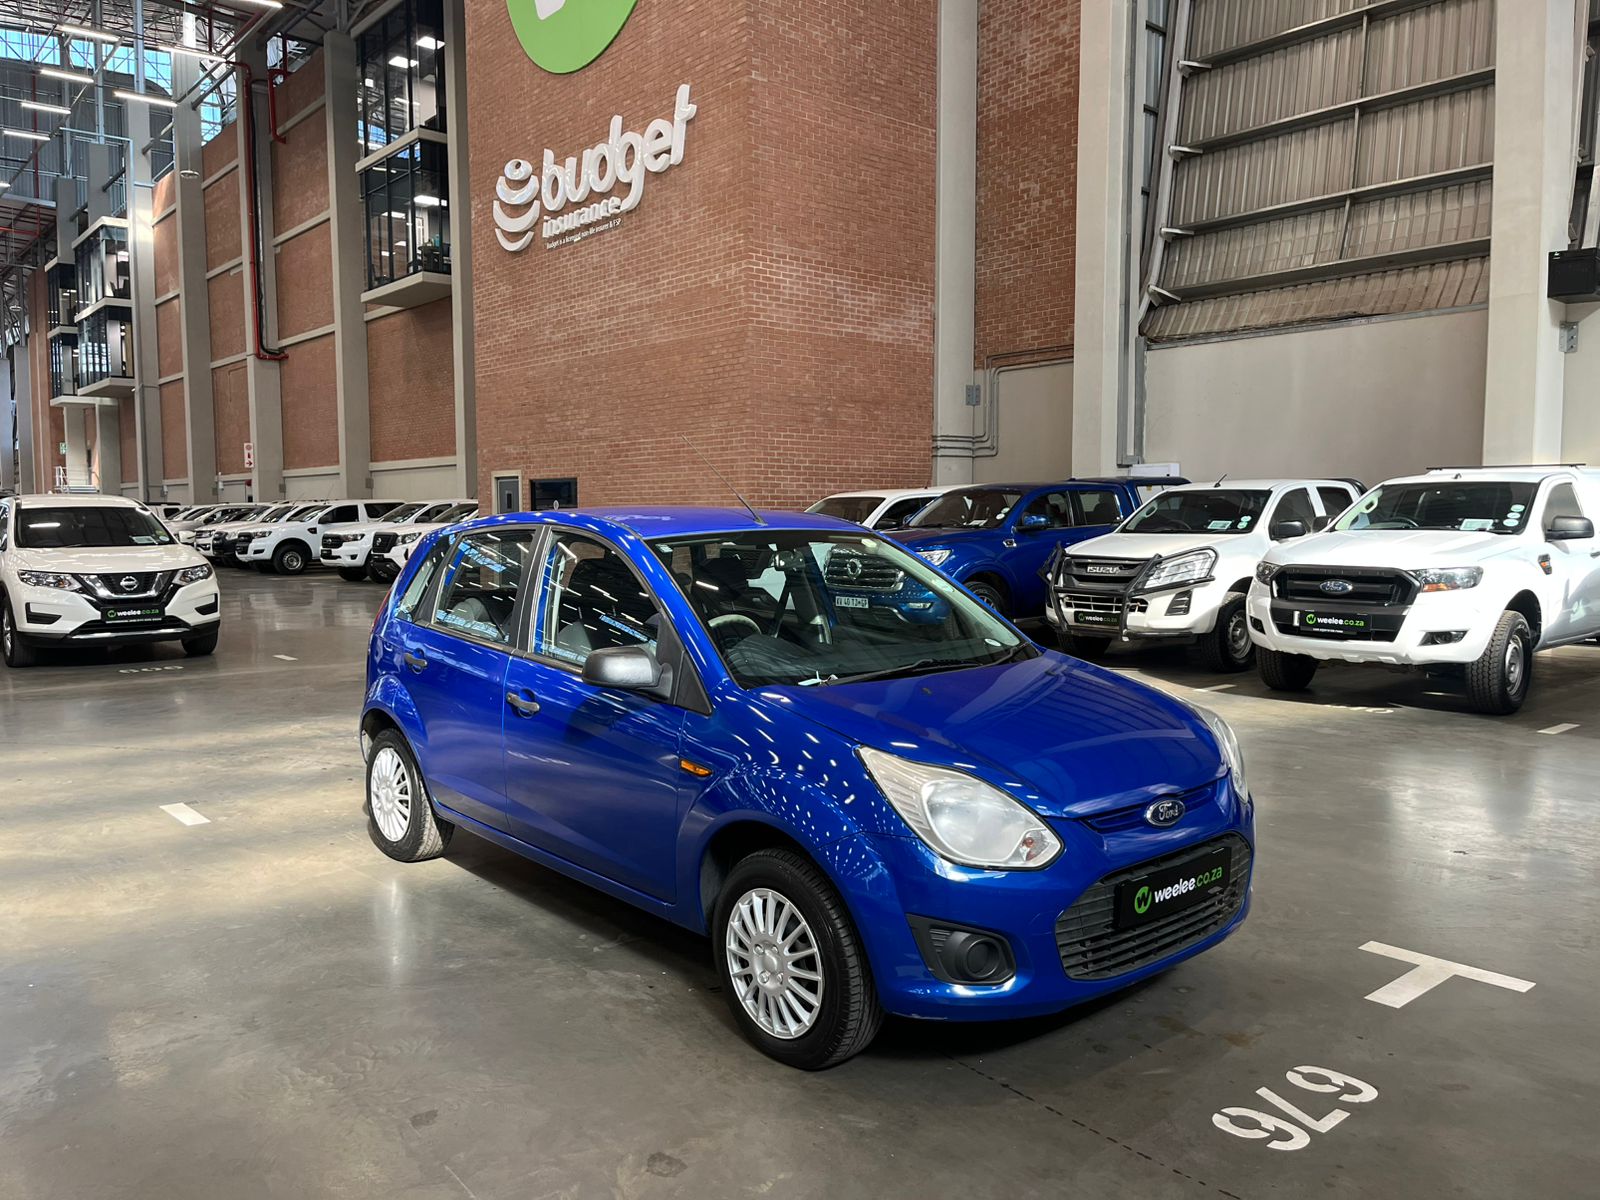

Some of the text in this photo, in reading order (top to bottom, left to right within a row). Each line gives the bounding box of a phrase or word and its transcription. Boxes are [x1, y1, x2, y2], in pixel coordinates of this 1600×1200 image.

[541, 84, 697, 212] budget
[542, 196, 621, 238] insurance
[1087, 566, 1119, 574] ISUZU
[1317, 616, 1364, 627] weelee.co.za
[1158, 802, 1179, 821] Ford
[1154, 866, 1223, 903] weelee.co.za
